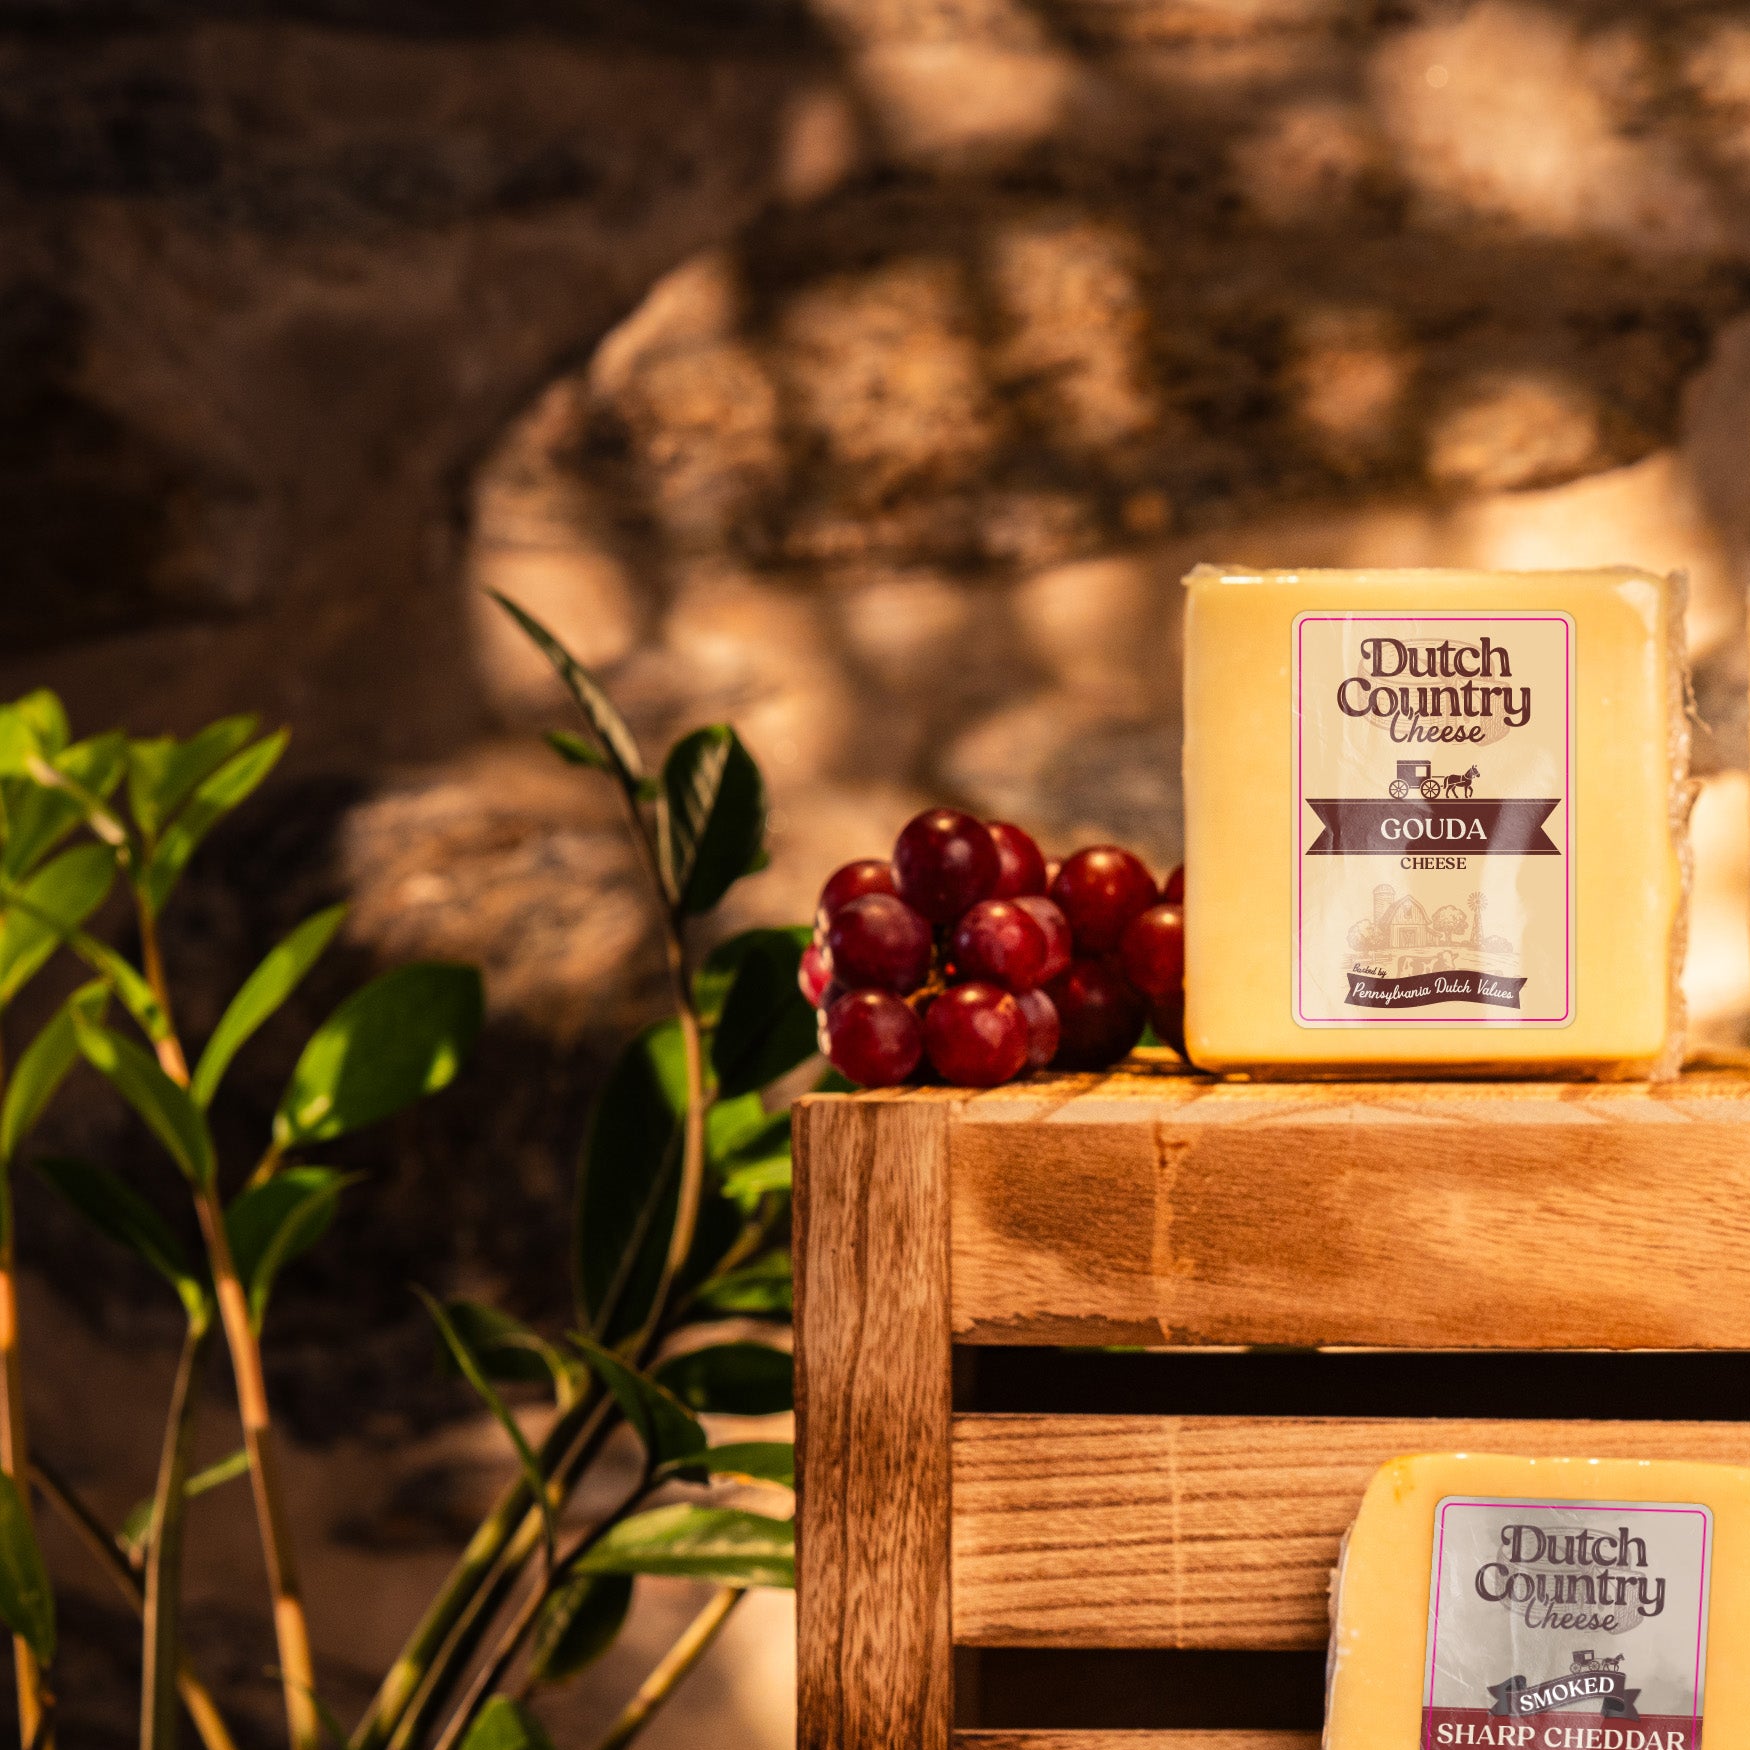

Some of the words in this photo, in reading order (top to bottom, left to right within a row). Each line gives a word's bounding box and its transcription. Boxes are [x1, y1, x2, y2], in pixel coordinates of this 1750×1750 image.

[1361, 637, 1512, 677] Dutch
[1337, 677, 1531, 727] Country
[1389, 710, 1486, 743] Cheese
[1380, 818, 1488, 840] GOUDA
[1400, 857, 1467, 870] CHEESE
[1353, 963, 1376, 975] Backed
[1377, 968, 1387, 978] by
[1352, 982, 1431, 1005] Pennsylvania
[1434, 977, 1472, 993] Dutch
[1477, 979, 1513, 999] Values
[1501, 1524, 1648, 1567] Dutch
[1475, 1563, 1665, 1616] Country
[1525, 1598, 1619, 1631] Cheese
[1520, 1675, 1614, 1713] SMOKED
[1437, 1723, 1535, 1746] SHARP
